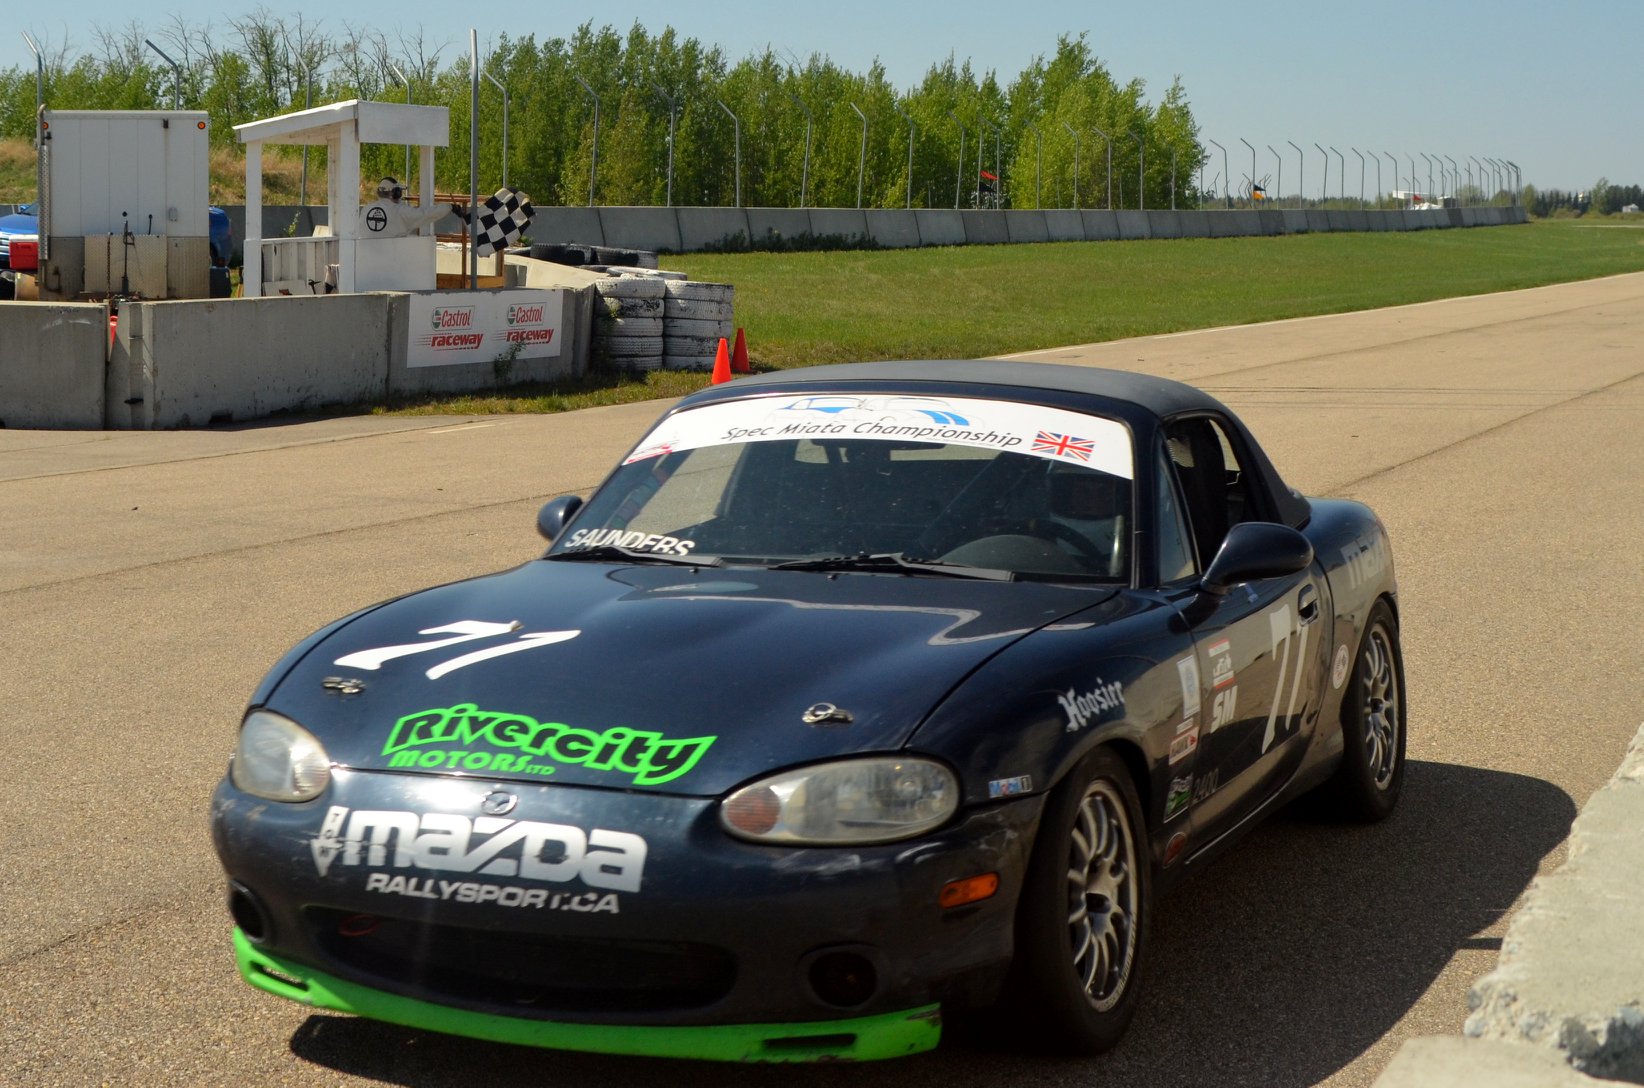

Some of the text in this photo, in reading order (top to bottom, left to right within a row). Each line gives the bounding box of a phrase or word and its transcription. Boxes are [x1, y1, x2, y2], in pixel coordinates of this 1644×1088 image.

[441, 309, 472, 328] Castrol
[515, 306, 544, 324] Castrol
[431, 333, 483, 350] raceway
[506, 328, 555, 344] raceway
[720, 426, 774, 441] Spec
[776, 420, 847, 435] Miata
[853, 421, 1023, 448] Championship
[564, 528, 696, 556] SAUNDERS
[1057, 676, 1126, 733] Hoosier
[382, 702, 717, 786] Rivercity
[387, 749, 534, 773] MOTORS
